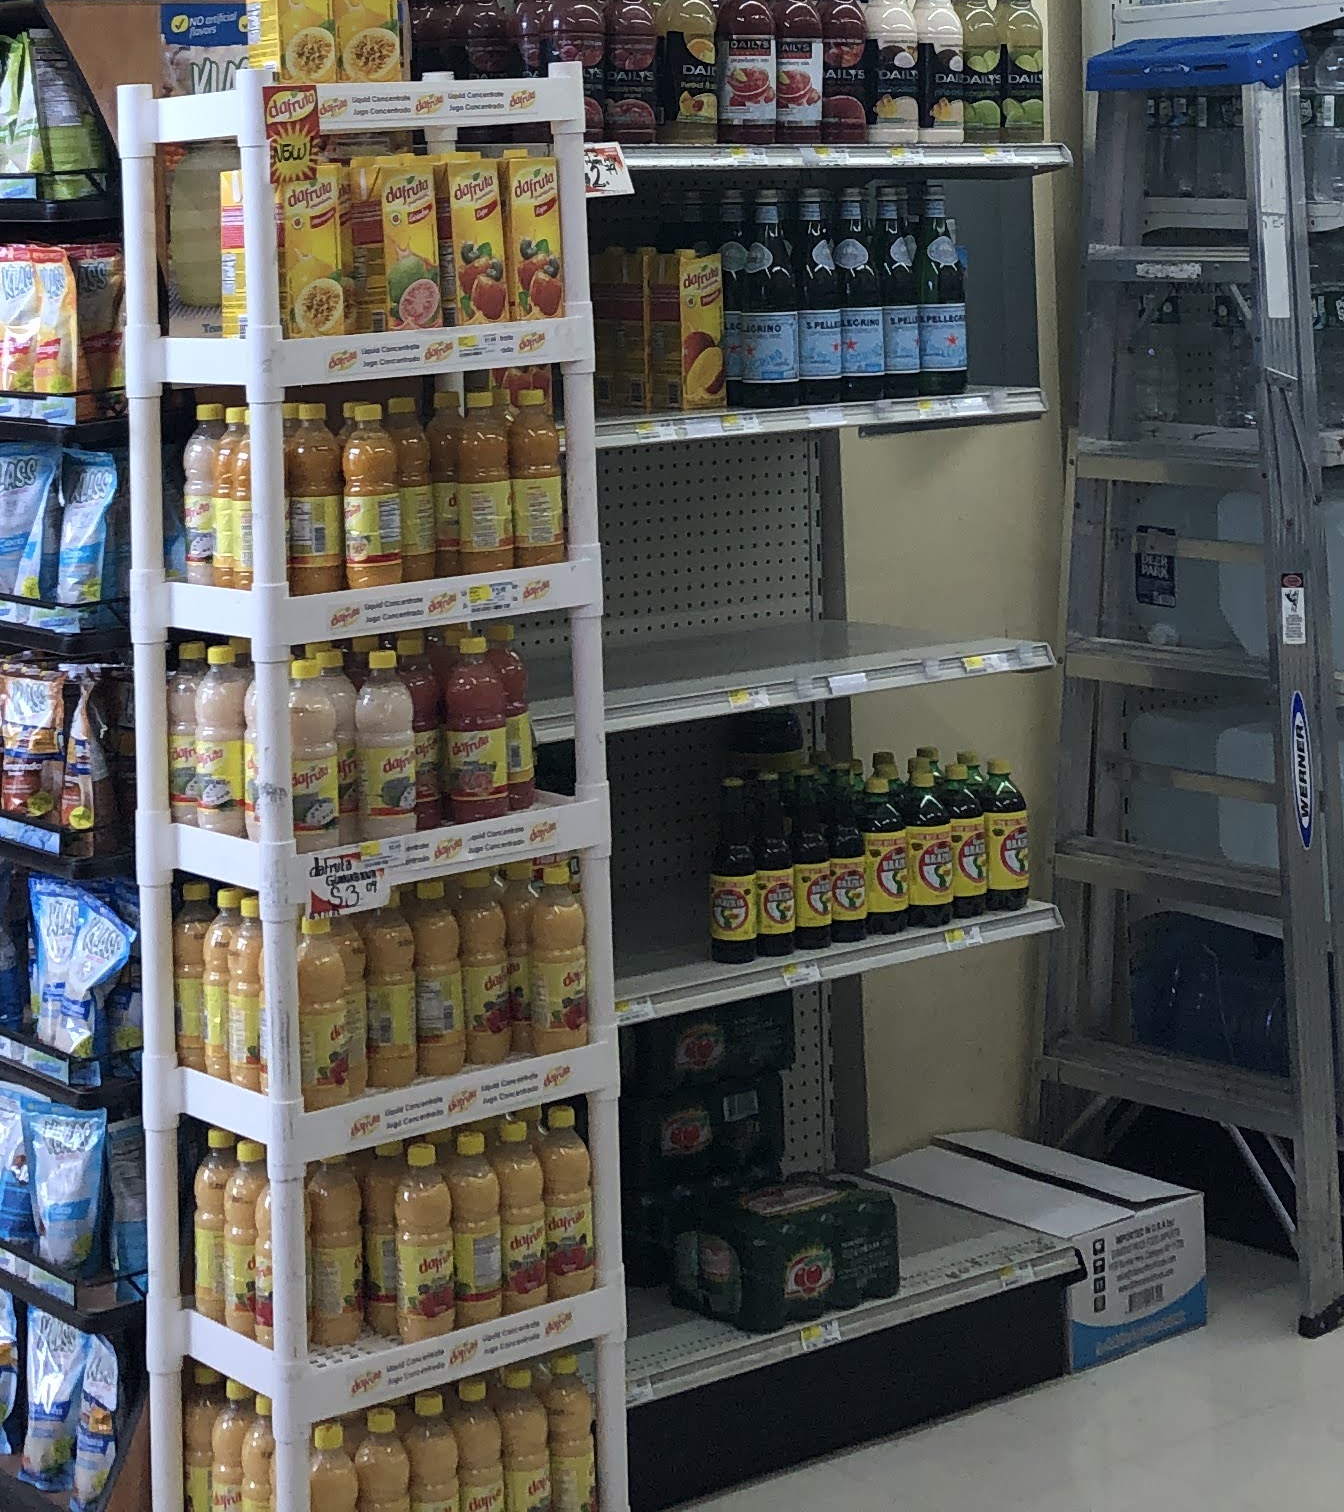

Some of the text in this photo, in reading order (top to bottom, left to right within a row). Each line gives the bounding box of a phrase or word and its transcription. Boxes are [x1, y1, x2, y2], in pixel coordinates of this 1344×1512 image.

[189, 16, 204, 26] NO
[268, 92, 316, 119] dafruta
[288, 182, 332, 209] dafruta
[386, 178, 429, 205] dafruta
[454, 176, 494, 202] dafruta
[514, 173, 555, 199] dafruta
[683, 268, 719, 289] dafruta
[1296, 724, 1312, 819] WERNER
